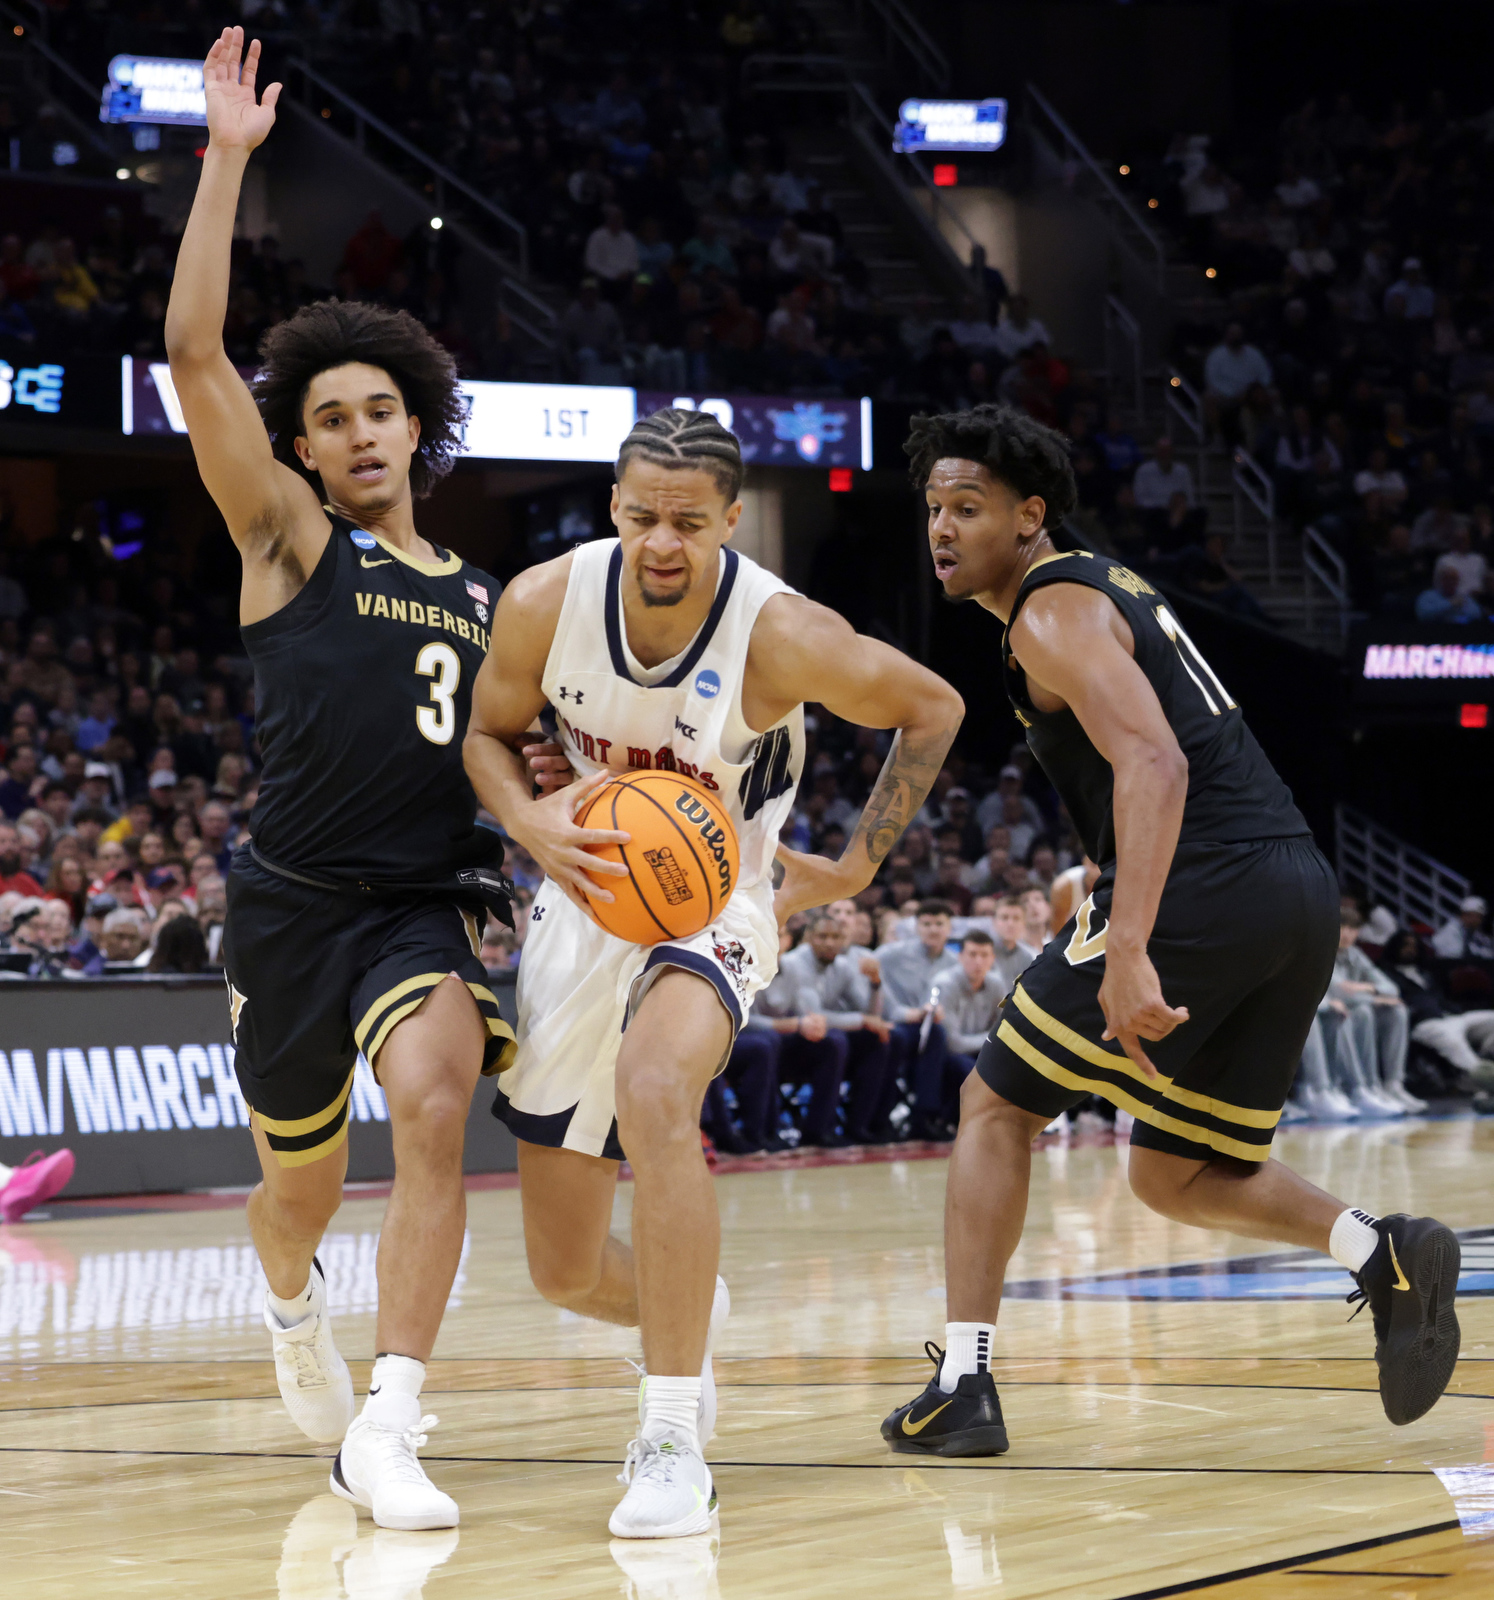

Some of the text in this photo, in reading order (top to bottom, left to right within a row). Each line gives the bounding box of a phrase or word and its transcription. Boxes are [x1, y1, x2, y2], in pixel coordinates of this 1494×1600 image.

[542, 408, 589, 438] 1ST
[355, 537, 376, 545] NCAA
[415, 641, 461, 746] 3
[696, 680, 718, 694] NCAA
[675, 715, 698, 741] WCC
[674, 790, 731, 902] Wilson
[655, 865, 682, 904] MADNESS
[663, 856, 687, 889] MARCH
